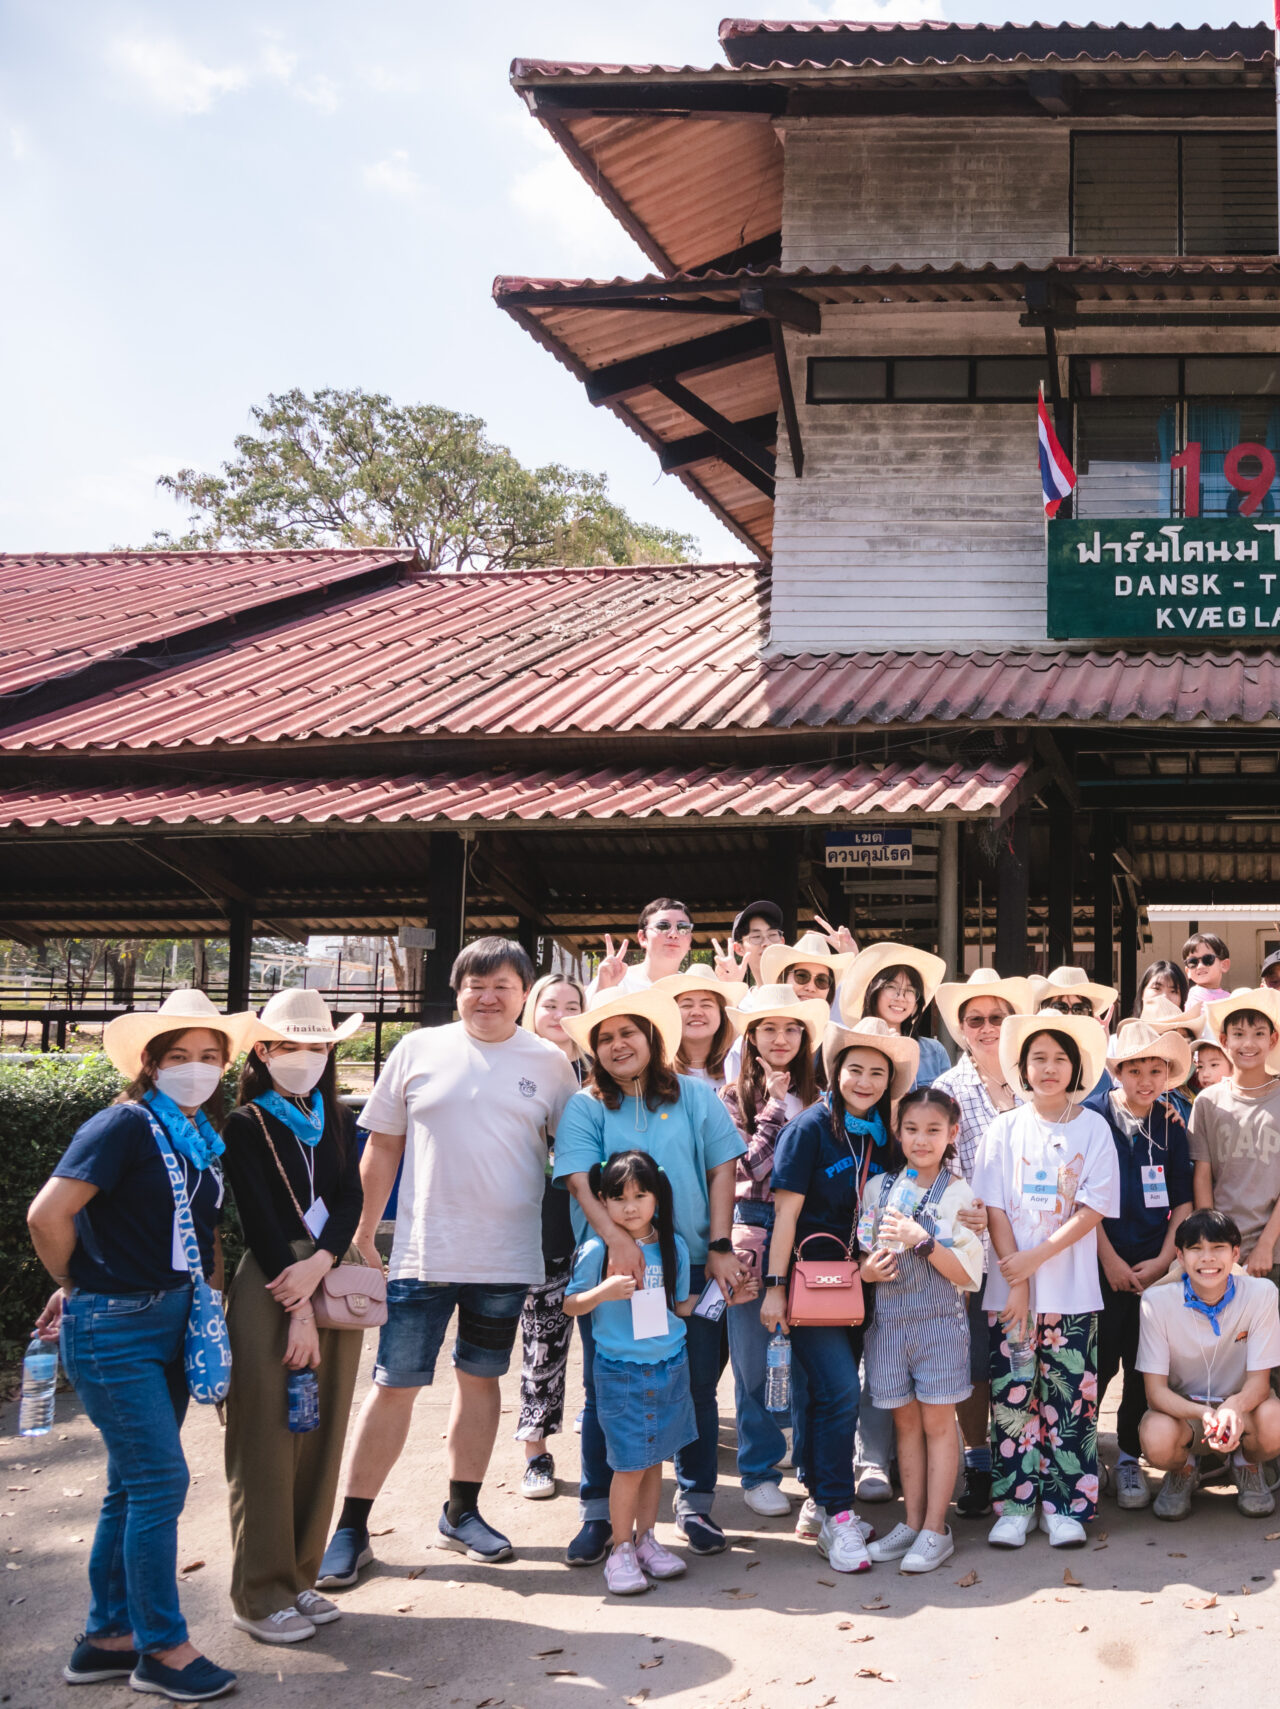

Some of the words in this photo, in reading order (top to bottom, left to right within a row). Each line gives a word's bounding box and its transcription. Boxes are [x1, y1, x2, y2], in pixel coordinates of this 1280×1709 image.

[1114, 573, 1222, 597] DANSK
[855, 833, 883, 843] เขต
[827, 845, 911, 866] ควบคุมโรค
